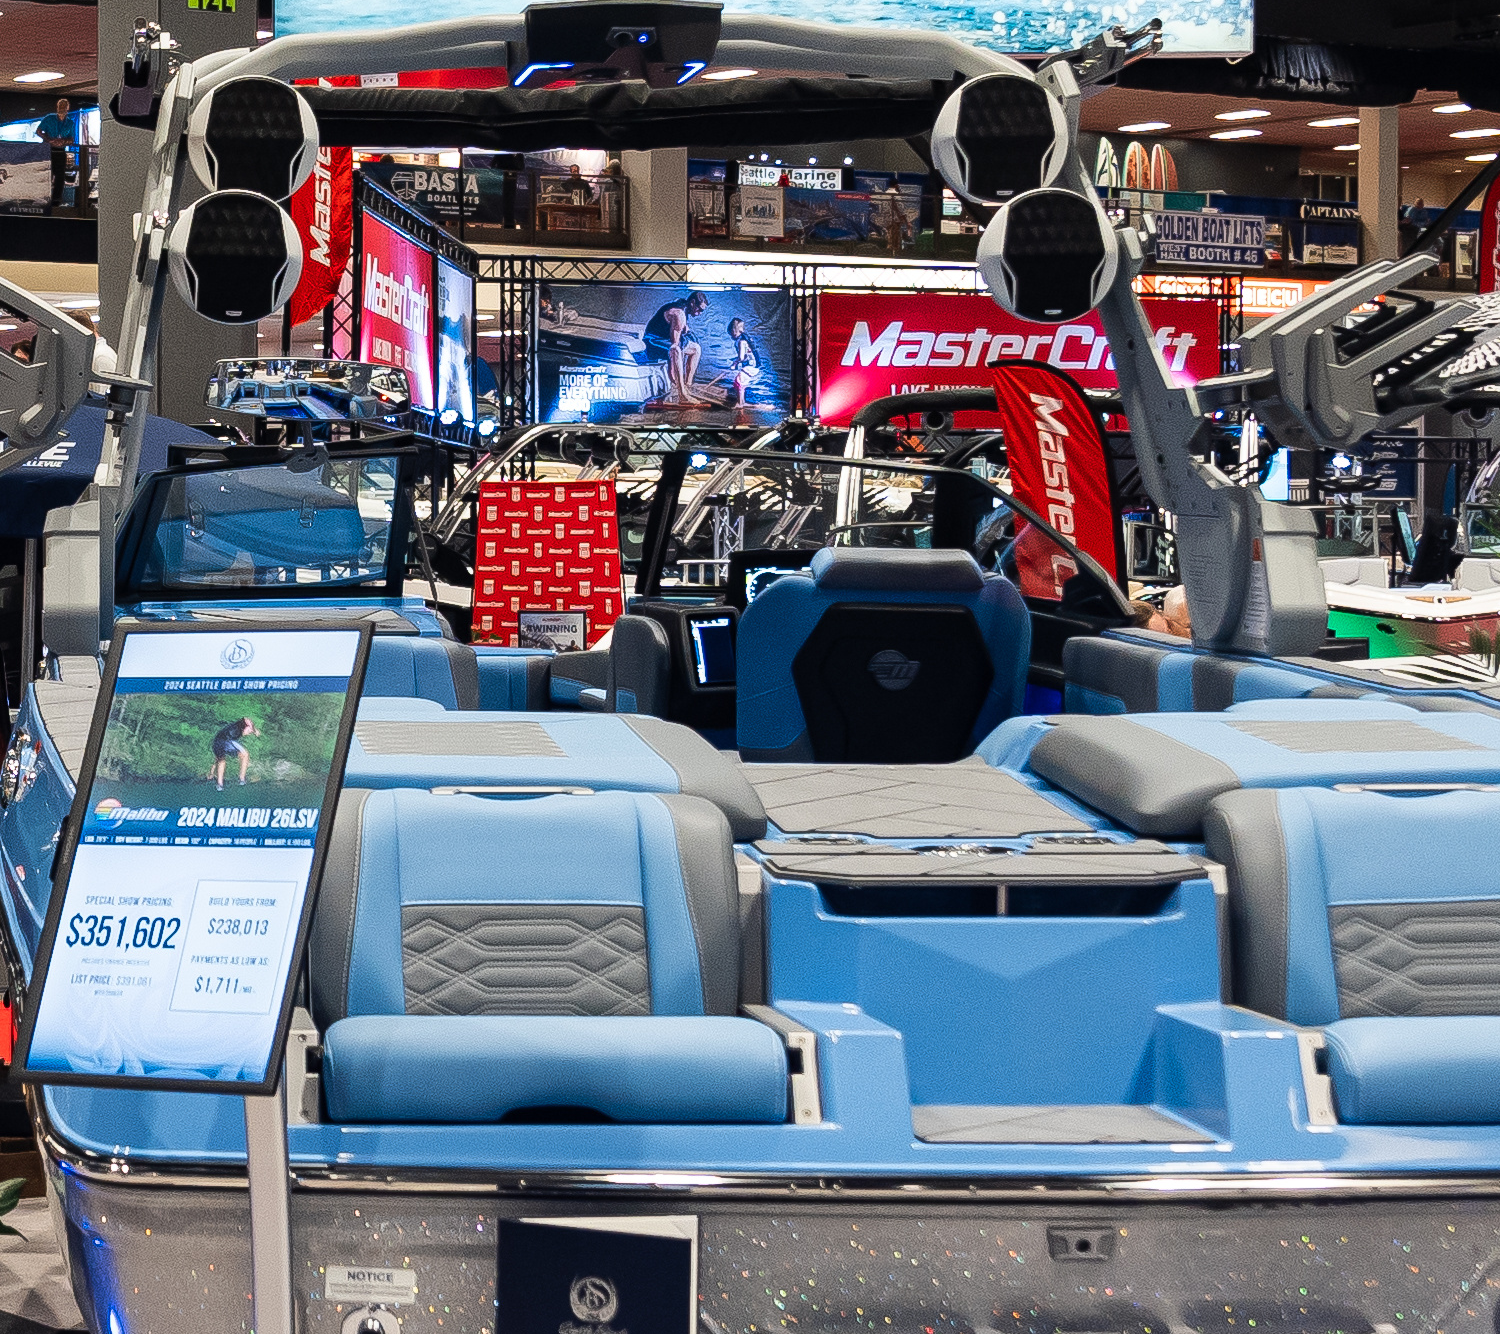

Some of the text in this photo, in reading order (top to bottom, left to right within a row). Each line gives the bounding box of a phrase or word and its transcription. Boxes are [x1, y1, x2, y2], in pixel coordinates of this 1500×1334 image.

[780, 168, 837, 182] Marine
[427, 194, 481, 205] BOATLFTS
[1156, 215, 1263, 246] GOLDEN BOAT LIFTS
[1160, 244, 1186, 253] WEST
[1160, 252, 1186, 261] HALL
[1189, 246, 1231, 262] BOOTH
[363, 252, 430, 338] MasterCraft
[841, 321, 1198, 372] MasterCrft
[559, 374, 609, 387] MORE OF
[559, 386, 628, 400] EVERYTHING
[164, 680, 184, 690] 2024
[186, 680, 219, 690] SEATTLE
[109, 806, 319, 828] Malibu 2024 MALIBU 26LSV
[85, 895, 115, 906] SPECIAL
[65, 912, 269, 953] $351,602 $238,013
[70, 974, 88, 985] LIST
[347, 1269, 394, 1283] NOTICE
